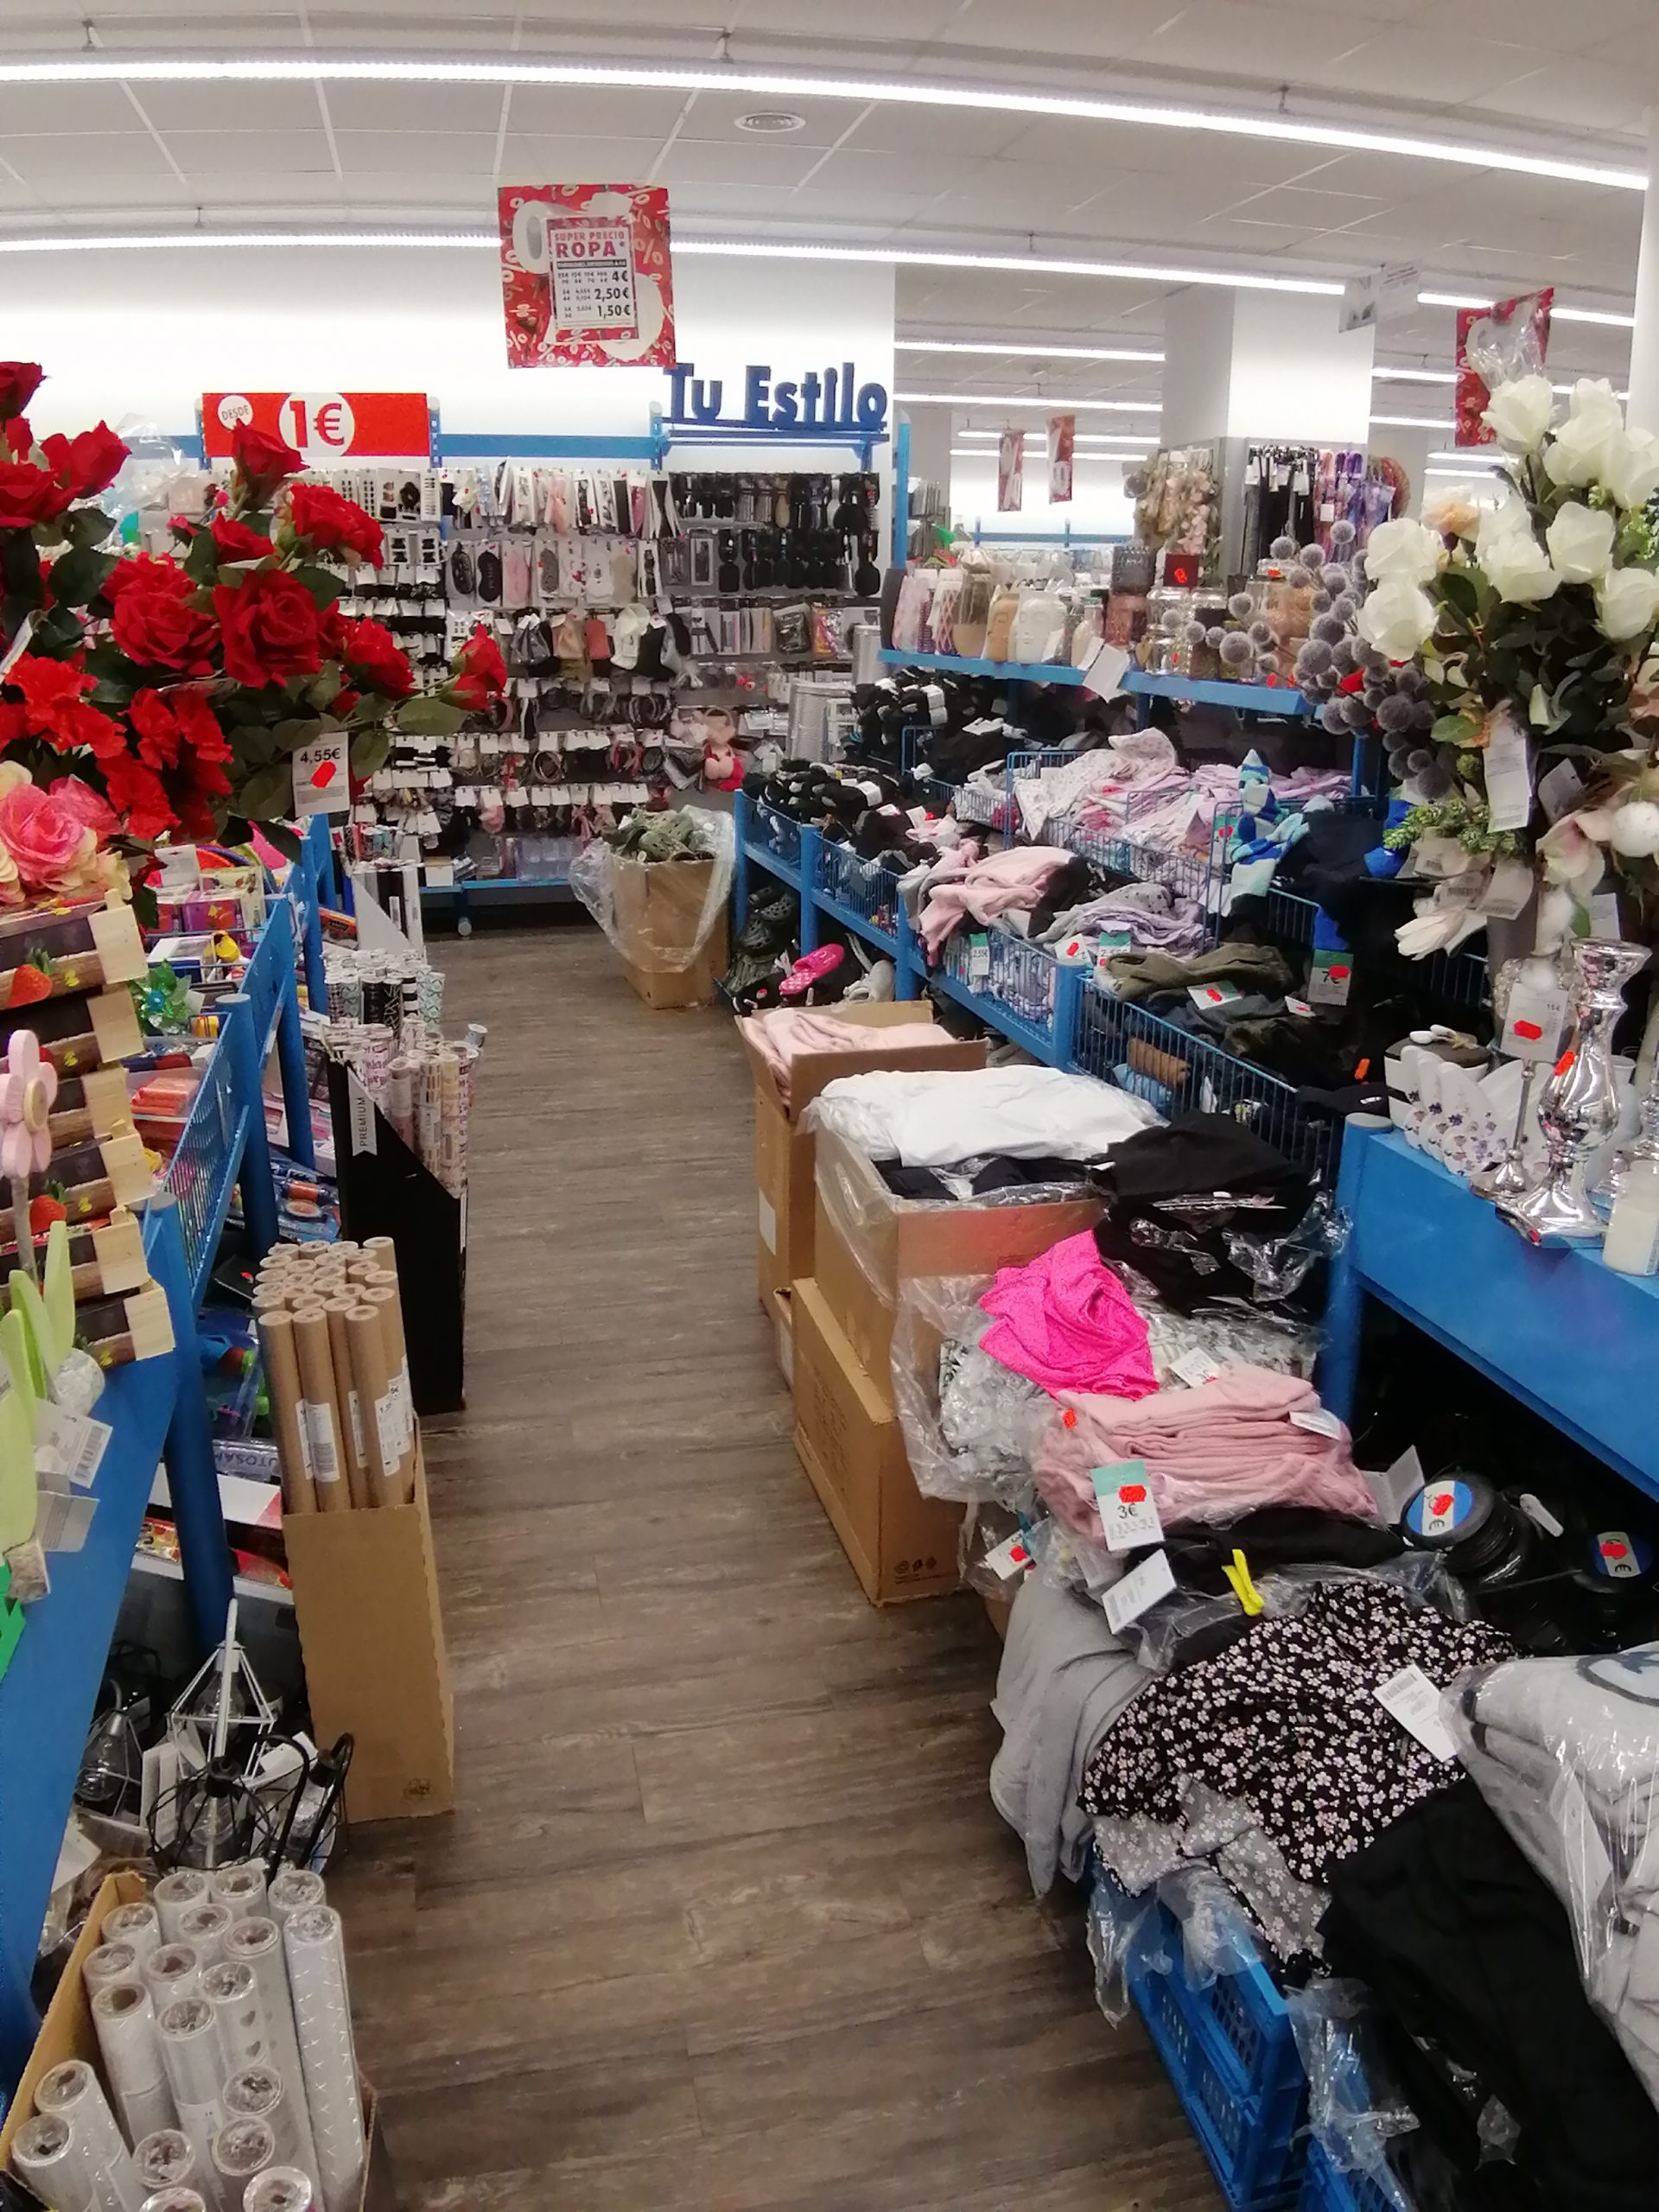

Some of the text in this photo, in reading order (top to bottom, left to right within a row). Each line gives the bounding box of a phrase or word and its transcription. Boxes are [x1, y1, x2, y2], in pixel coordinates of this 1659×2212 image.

[555, 232, 625, 241] SUPER PRECIO
[556, 241, 617, 258] ROPA
[612, 270, 628, 283] 4€
[594, 287, 629, 302] 2,50€
[597, 304, 631, 319] 1,50€
[663, 362, 887, 426] Tu Estilo
[221, 404, 250, 421] DESDE
[289, 400, 345, 448] 1€
[300, 747, 340, 764] 4,55€
[357, 1097, 368, 1147] PREMIUM
[1117, 1503, 1139, 1519] 3€
